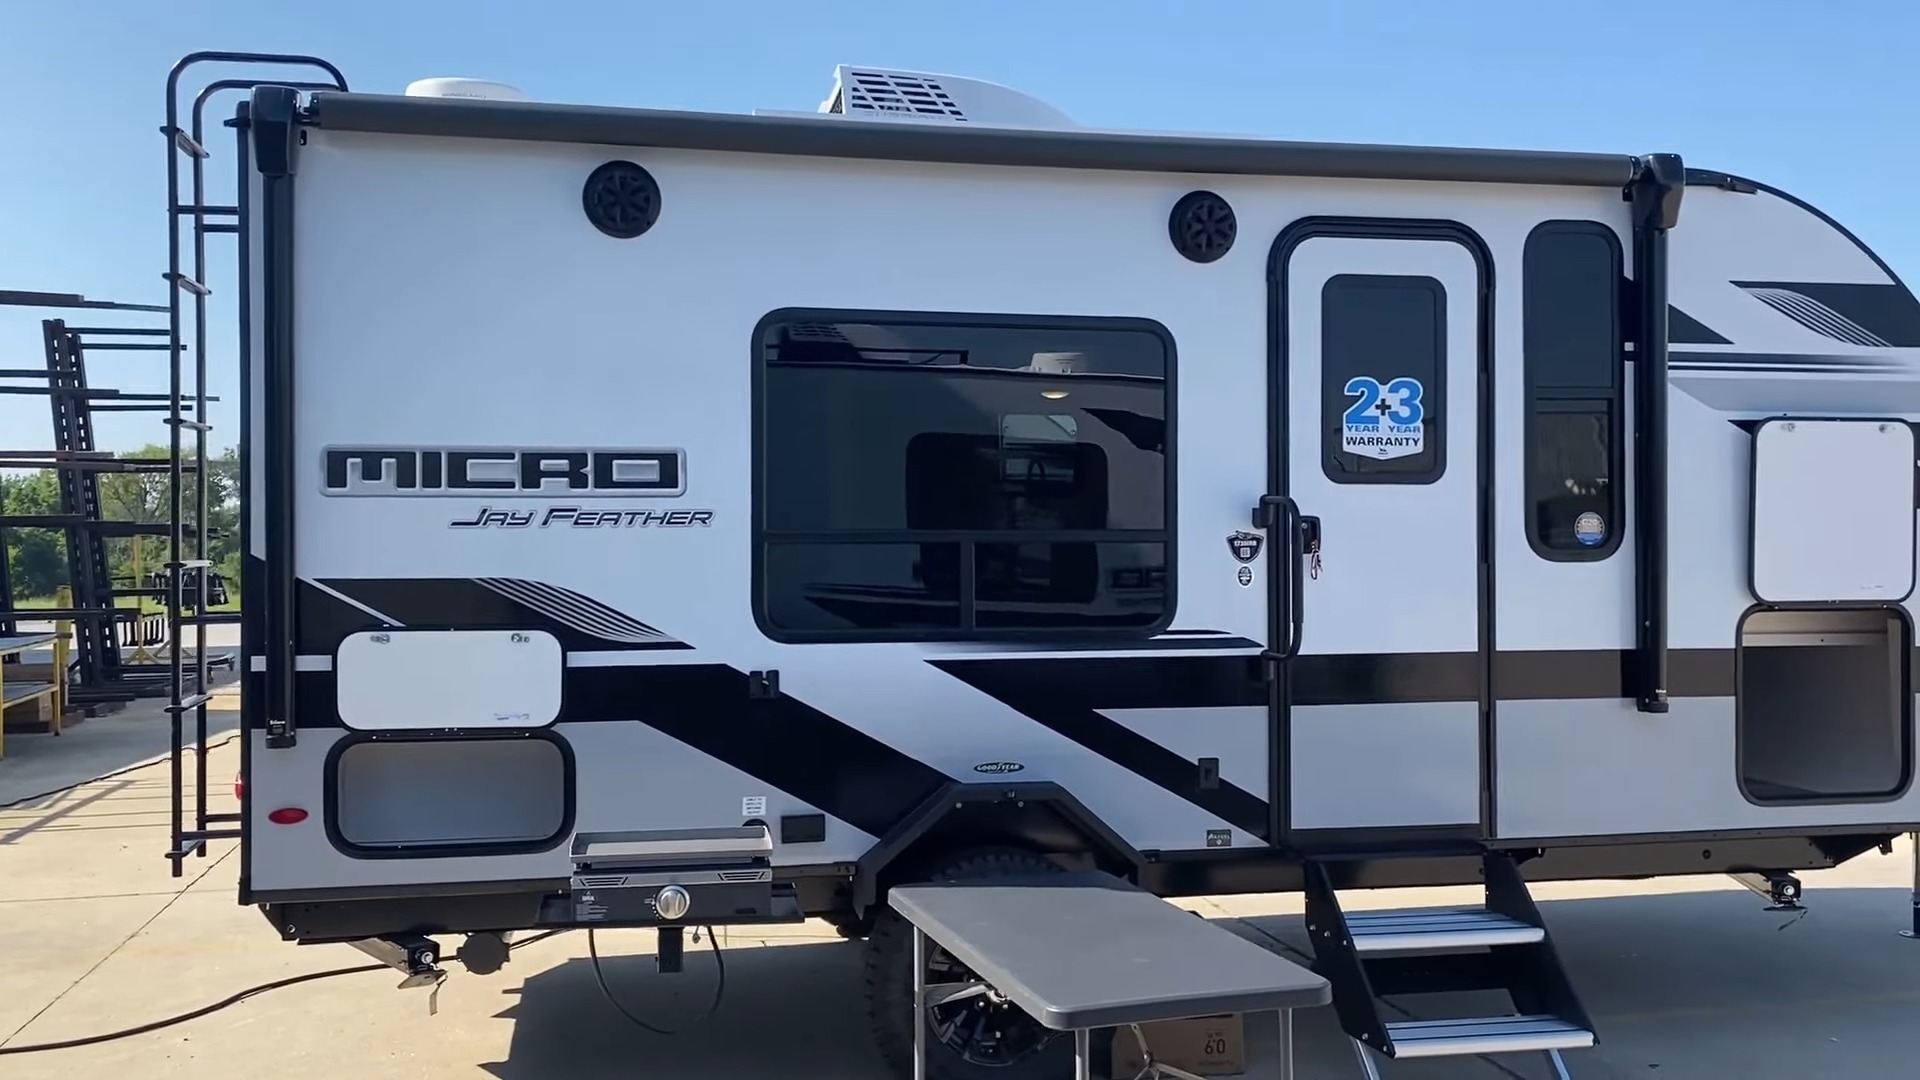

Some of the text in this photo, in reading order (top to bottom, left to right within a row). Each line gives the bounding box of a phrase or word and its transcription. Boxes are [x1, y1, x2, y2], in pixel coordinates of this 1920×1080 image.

[1345, 424, 1379, 433] YEAR
[1387, 425, 1420, 434] YEAR
[1345, 436, 1420, 447] WARRANTY
[326, 450, 679, 490] MICRO
[450, 507, 713, 527] JAY FEATHER
